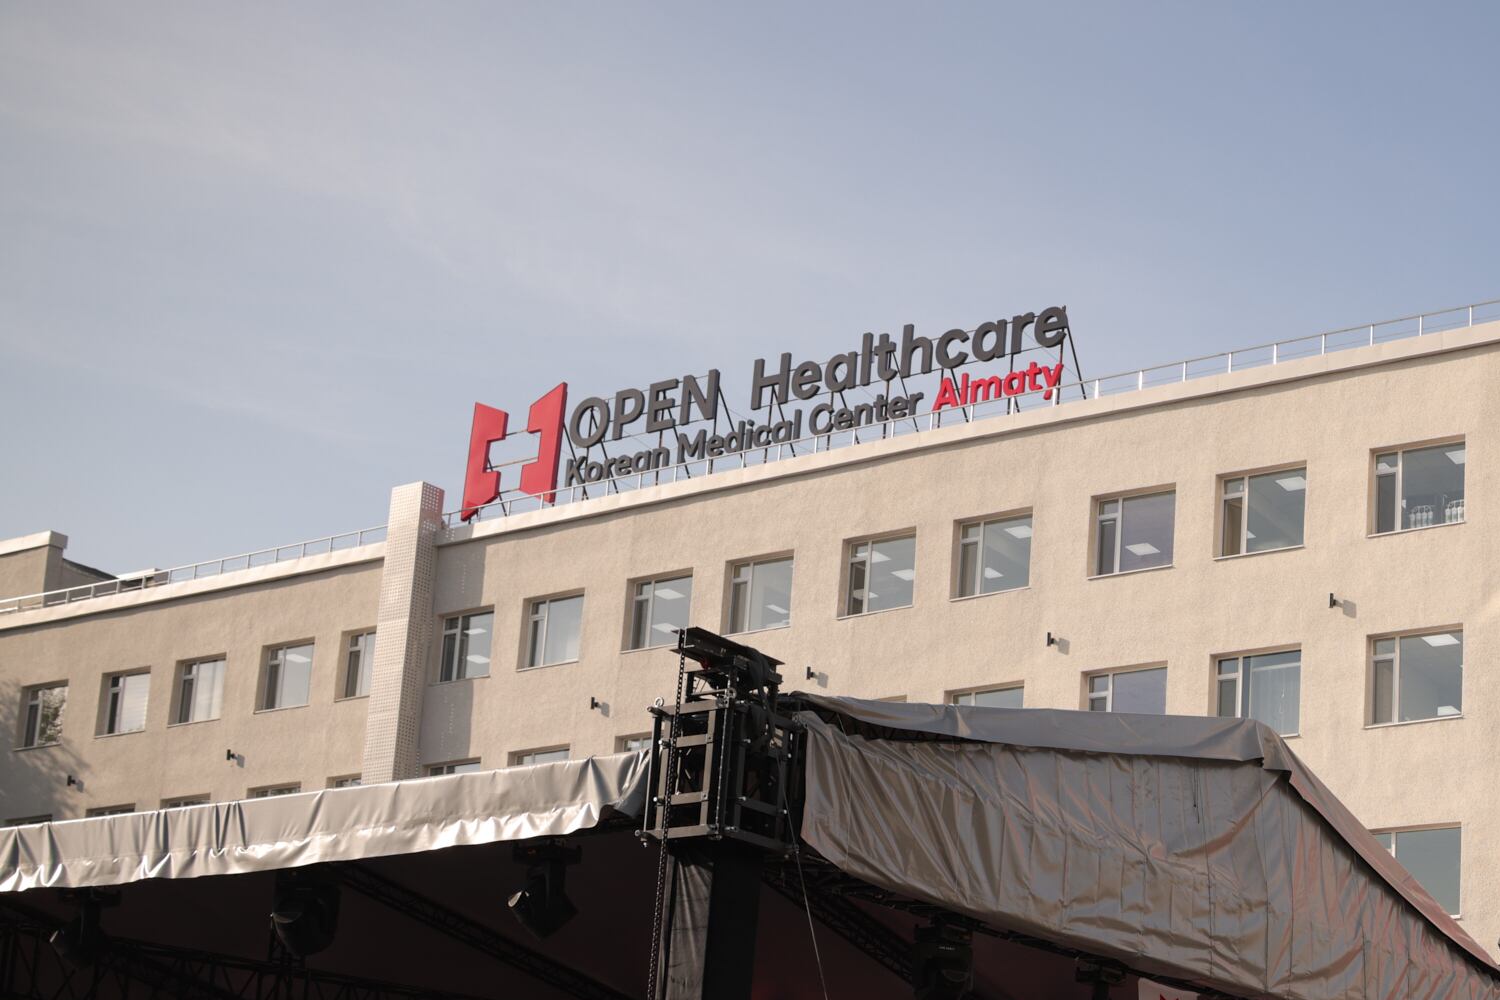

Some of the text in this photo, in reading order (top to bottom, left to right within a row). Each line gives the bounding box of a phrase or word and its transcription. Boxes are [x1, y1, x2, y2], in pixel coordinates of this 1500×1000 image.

[565, 361, 1064, 488] Korean Medical Center Almaty
[570, 306, 1067, 448] OPEN Healthcare
